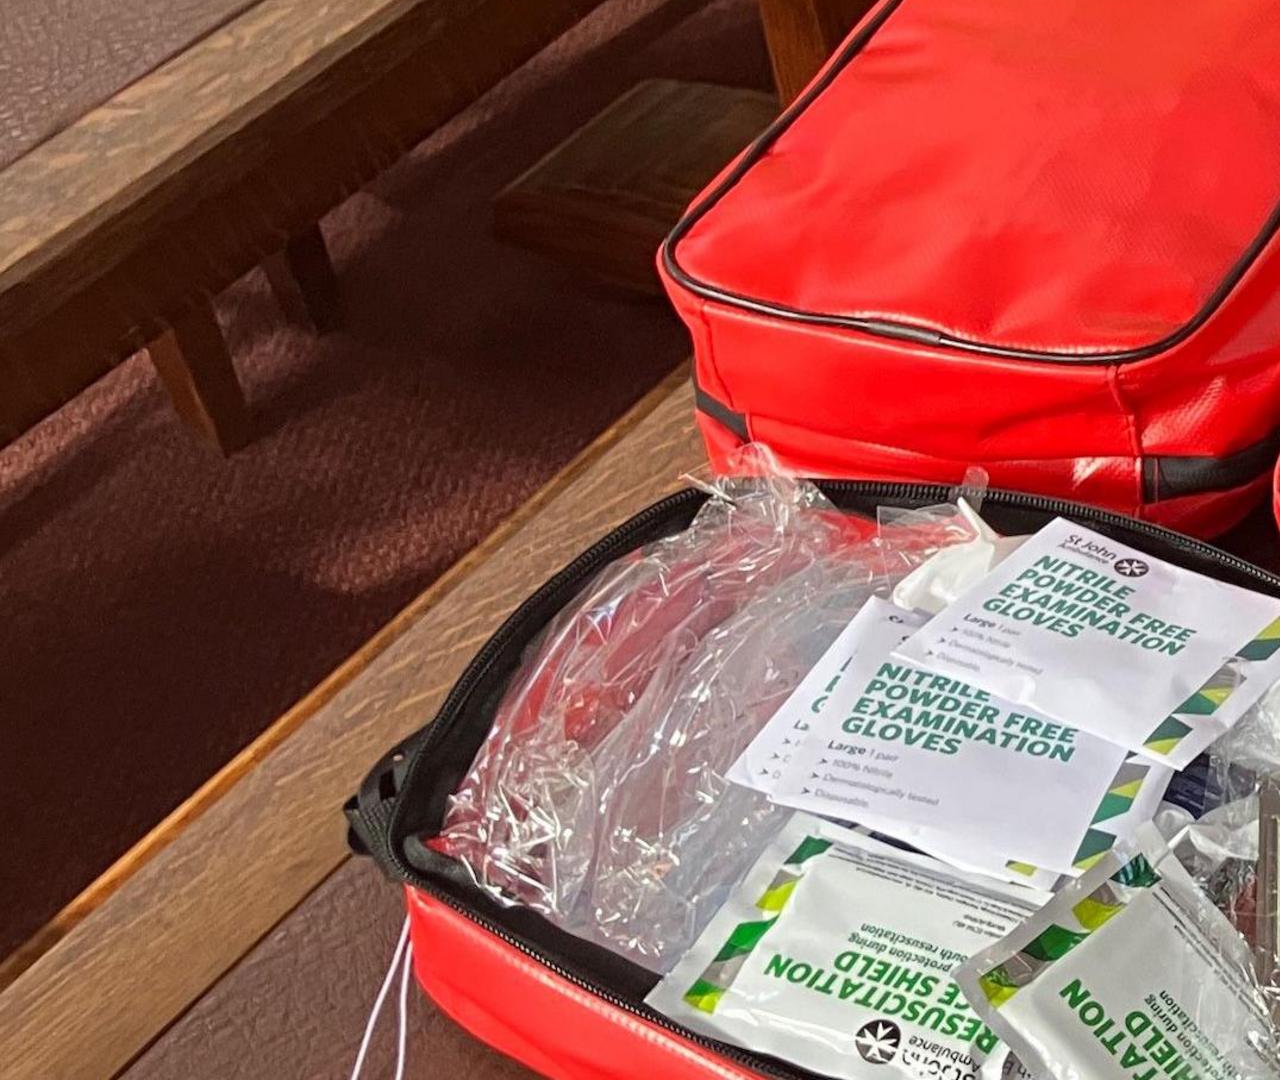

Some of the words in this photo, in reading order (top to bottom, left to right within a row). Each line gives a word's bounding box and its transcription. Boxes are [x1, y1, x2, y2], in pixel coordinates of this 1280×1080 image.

[1063, 533, 1082, 548] St
[1081, 539, 1117, 562] John
[1033, 554, 1137, 601] NITRILE
[962, 613, 997, 629] Large
[982, 597, 1086, 638] GLOVES
[998, 582, 1187, 656] EXAMINATION
[1018, 568, 1132, 618] POWDER
[1128, 612, 1198, 642] FREE
[876, 661, 993, 703] NITRILE
[851, 697, 1077, 763] EXAMINATION
[864, 678, 1001, 725] POWDER
[1003, 711, 1080, 743] FREE
[827, 739, 867, 756] Large
[875, 750, 900, 763] pair
[841, 716, 963, 755] GLOVES
[848, 931, 887, 954] during
[860, 922, 942, 955] resuscitation
[888, 944, 952, 972] protection
[833, 950, 940, 997] SHIELD
[762, 952, 1001, 1056] RESUSCITATION
[938, 982, 971, 1011] CE
[1144, 993, 1179, 1033] during
[908, 1035, 982, 1073] Ambulance
[1124, 1010, 1201, 1080] HIELD
